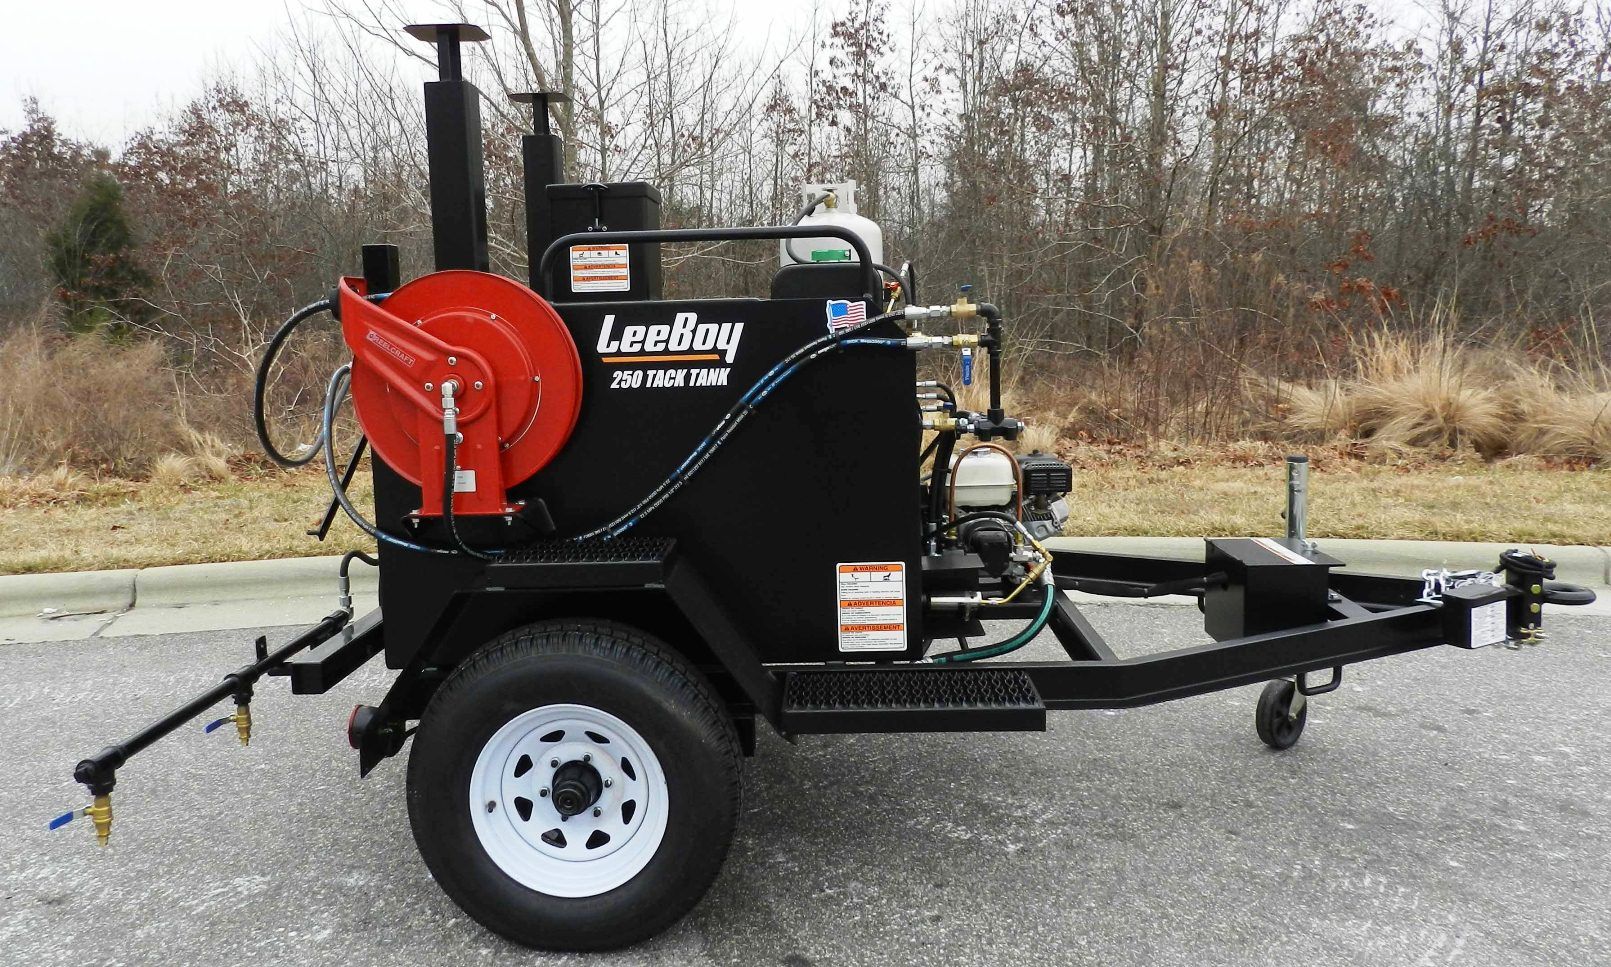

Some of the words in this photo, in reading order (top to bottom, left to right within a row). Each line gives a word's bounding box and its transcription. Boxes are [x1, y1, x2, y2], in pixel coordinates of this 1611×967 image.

[374, 335, 414, 365] REELCRAFT
[596, 312, 744, 364] LeeBoy
[610, 370, 643, 389] 250
[645, 368, 687, 388] TACK
[689, 367, 731, 387] TANK
